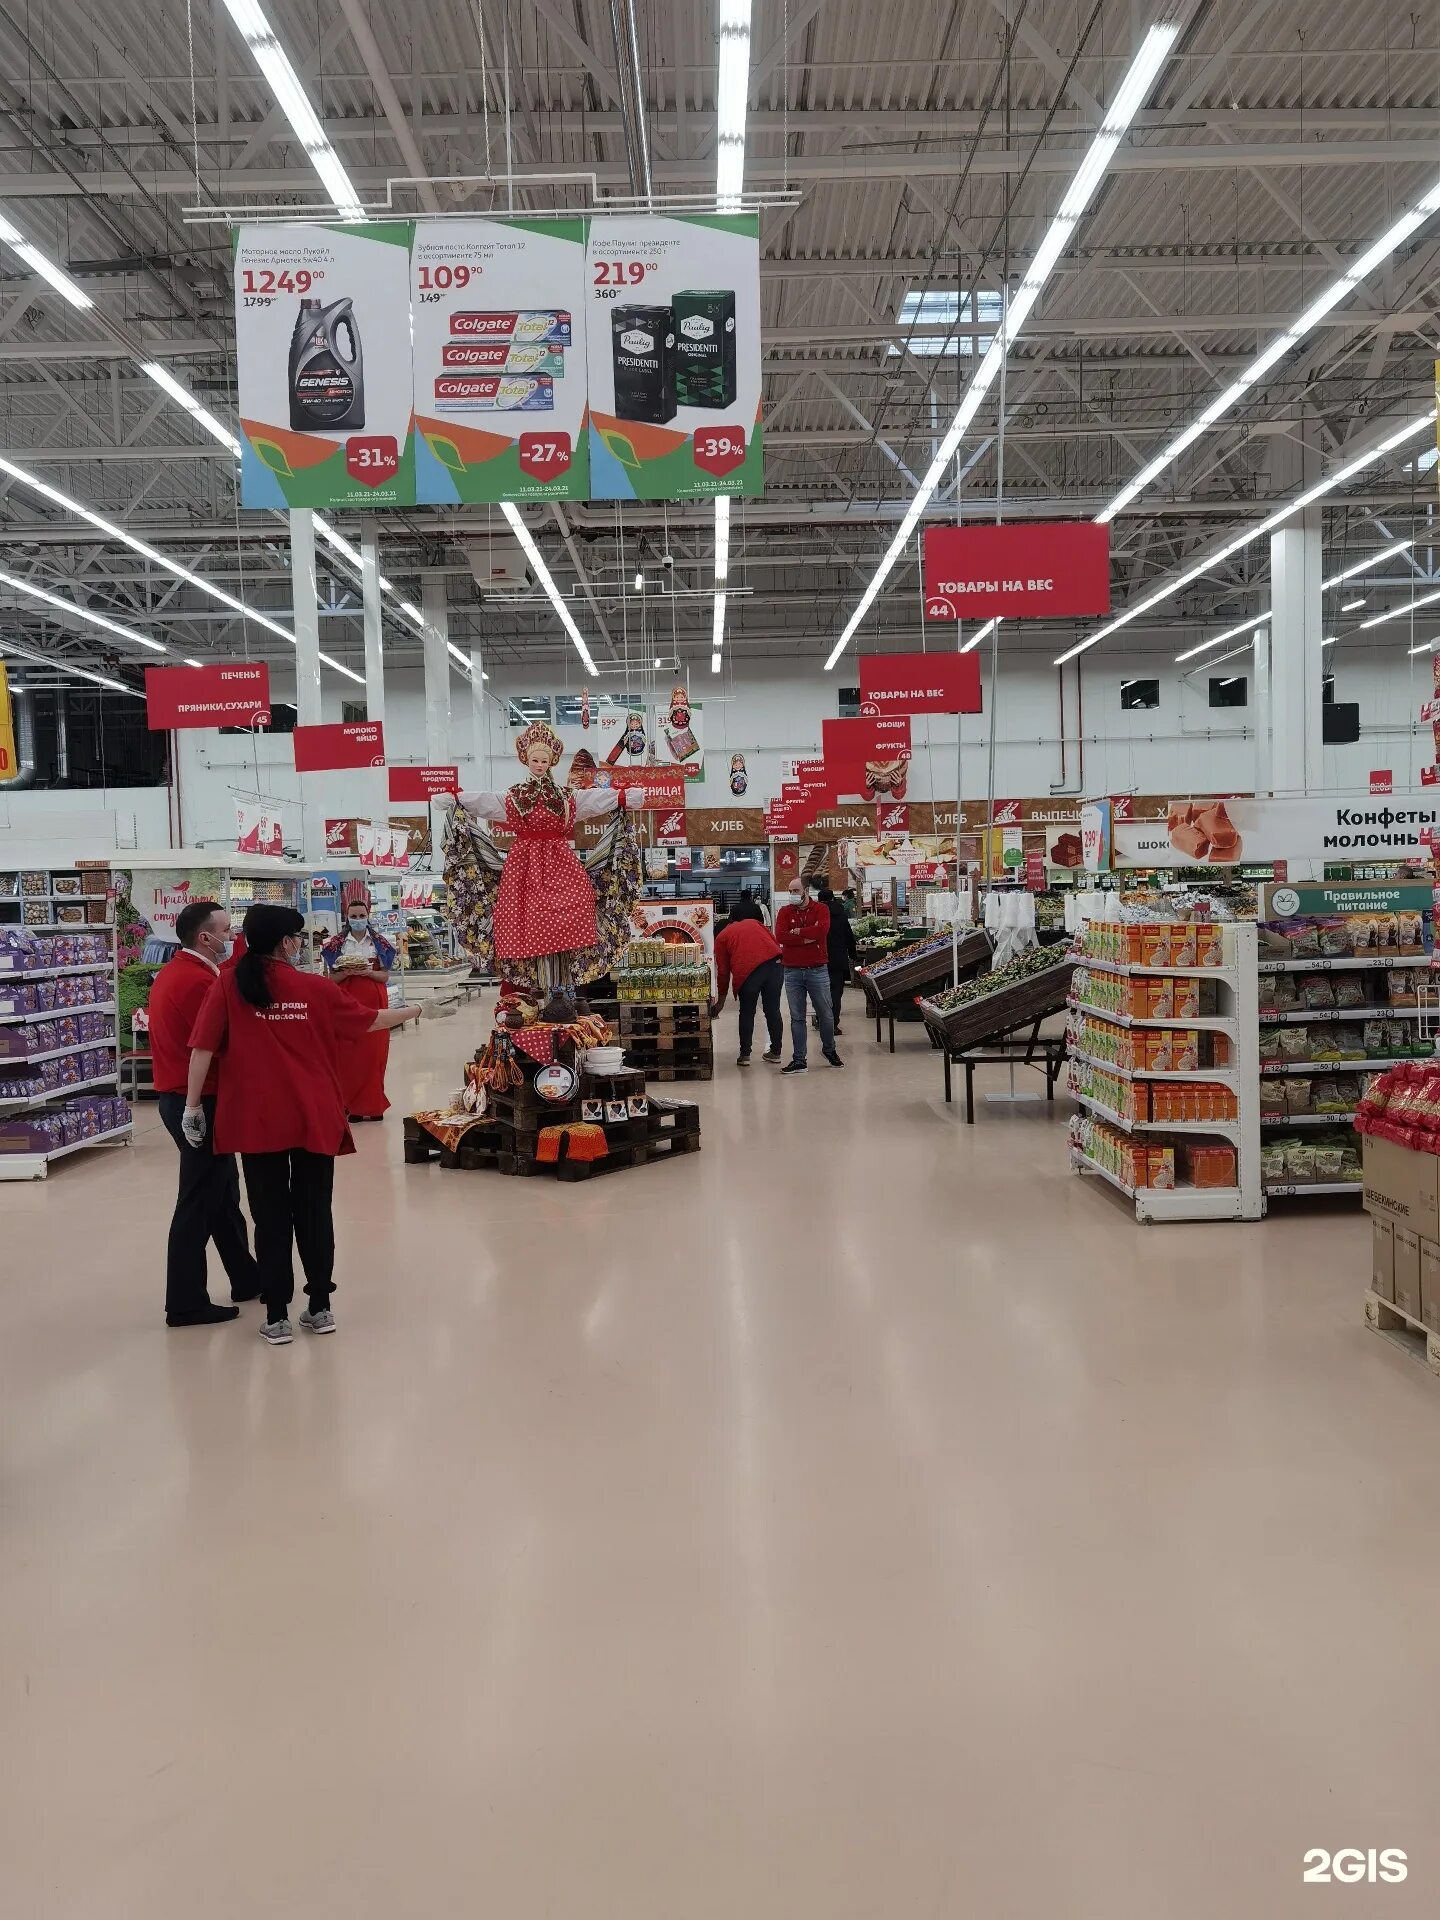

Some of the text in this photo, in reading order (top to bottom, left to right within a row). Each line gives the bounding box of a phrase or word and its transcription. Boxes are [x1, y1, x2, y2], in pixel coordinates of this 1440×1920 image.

[418, 265, 483, 290] 109 90
[593, 262, 658, 285] 219 00
[242, 270, 325, 294] 1249 00
[418, 293, 440, 303] 149
[594, 288, 616, 299] 360
[242, 297, 272, 307] 1799
[454, 318, 512, 332] Colgate
[518, 321, 548, 332] Total
[683, 322, 712, 334] Paulig
[624, 335, 652, 349] Paulig
[677, 342, 718, 353] PRESIDENTTI
[446, 350, 504, 363] Colgate
[509, 353, 540, 362] Total
[617, 356, 658, 368] PRESIDENTTI
[299, 378, 350, 386] GENESIS
[438, 382, 496, 396] Colgate
[500, 386, 530, 395] Total
[522, 444, 569, 462] -27%
[696, 437, 744, 457] -39%
[348, 448, 396, 467] -31%
[694, 480, 743, 488] 11.03.21-24.03.21
[938, 579, 1053, 594] ТОВАРЫ НА ВЕС
[929, 605, 949, 616] 44
[221, 670, 261, 680] ПЕЧЕНЬЕ
[868, 688, 944, 700] ТОВАРЫ НА ВЕС
[178, 700, 262, 712] ПРЯНИКИ,СУХАРИ
[862, 707, 876, 715] 46
[343, 727, 377, 735] МОЛОКО
[356, 734, 378, 742] ЯЙЦО
[644, 786, 681, 796] ЕНИЦА!
[934, 814, 967, 825] ХЛЕБ
[1336, 807, 1436, 829] Конфеты
[710, 820, 744, 832] ХЛЕБ
[1084, 830, 1096, 848] 299
[1324, 890, 1400, 904] Правильное
[1337, 901, 1388, 911] питание
[282, 1002, 308, 1011] рады
